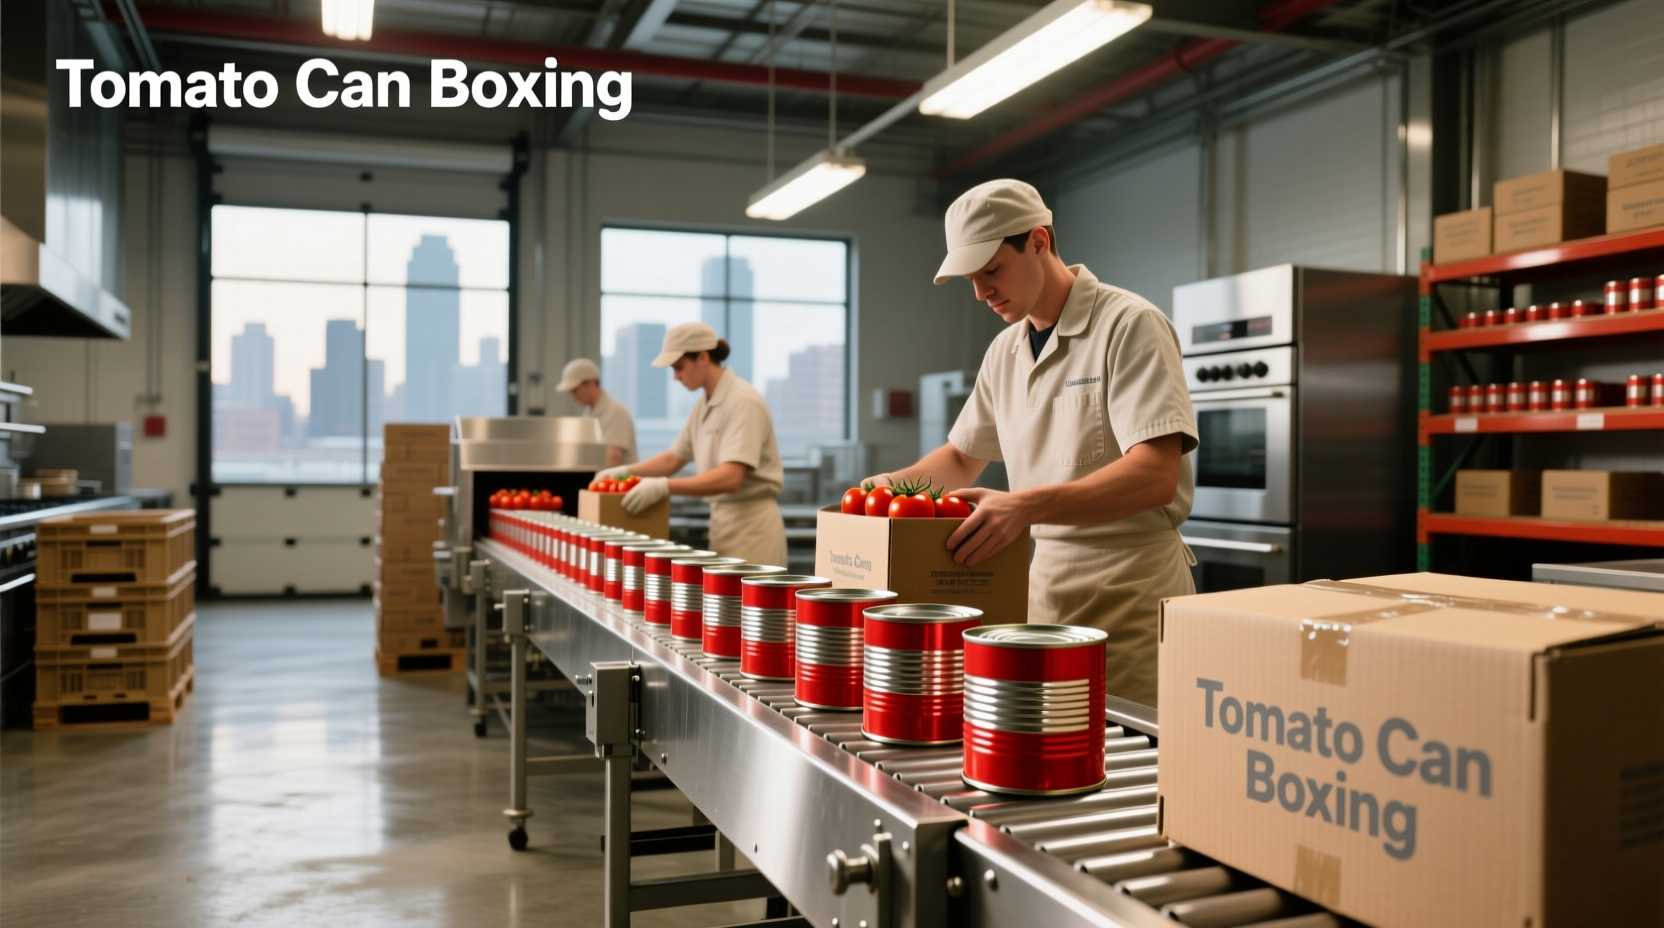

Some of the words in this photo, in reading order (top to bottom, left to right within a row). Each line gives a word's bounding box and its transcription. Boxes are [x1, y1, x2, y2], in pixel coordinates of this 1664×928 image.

[1196, 677, 1364, 764] Tomato
[1377, 717, 1493, 798] Can
[1246, 748, 1418, 861] Boxing
